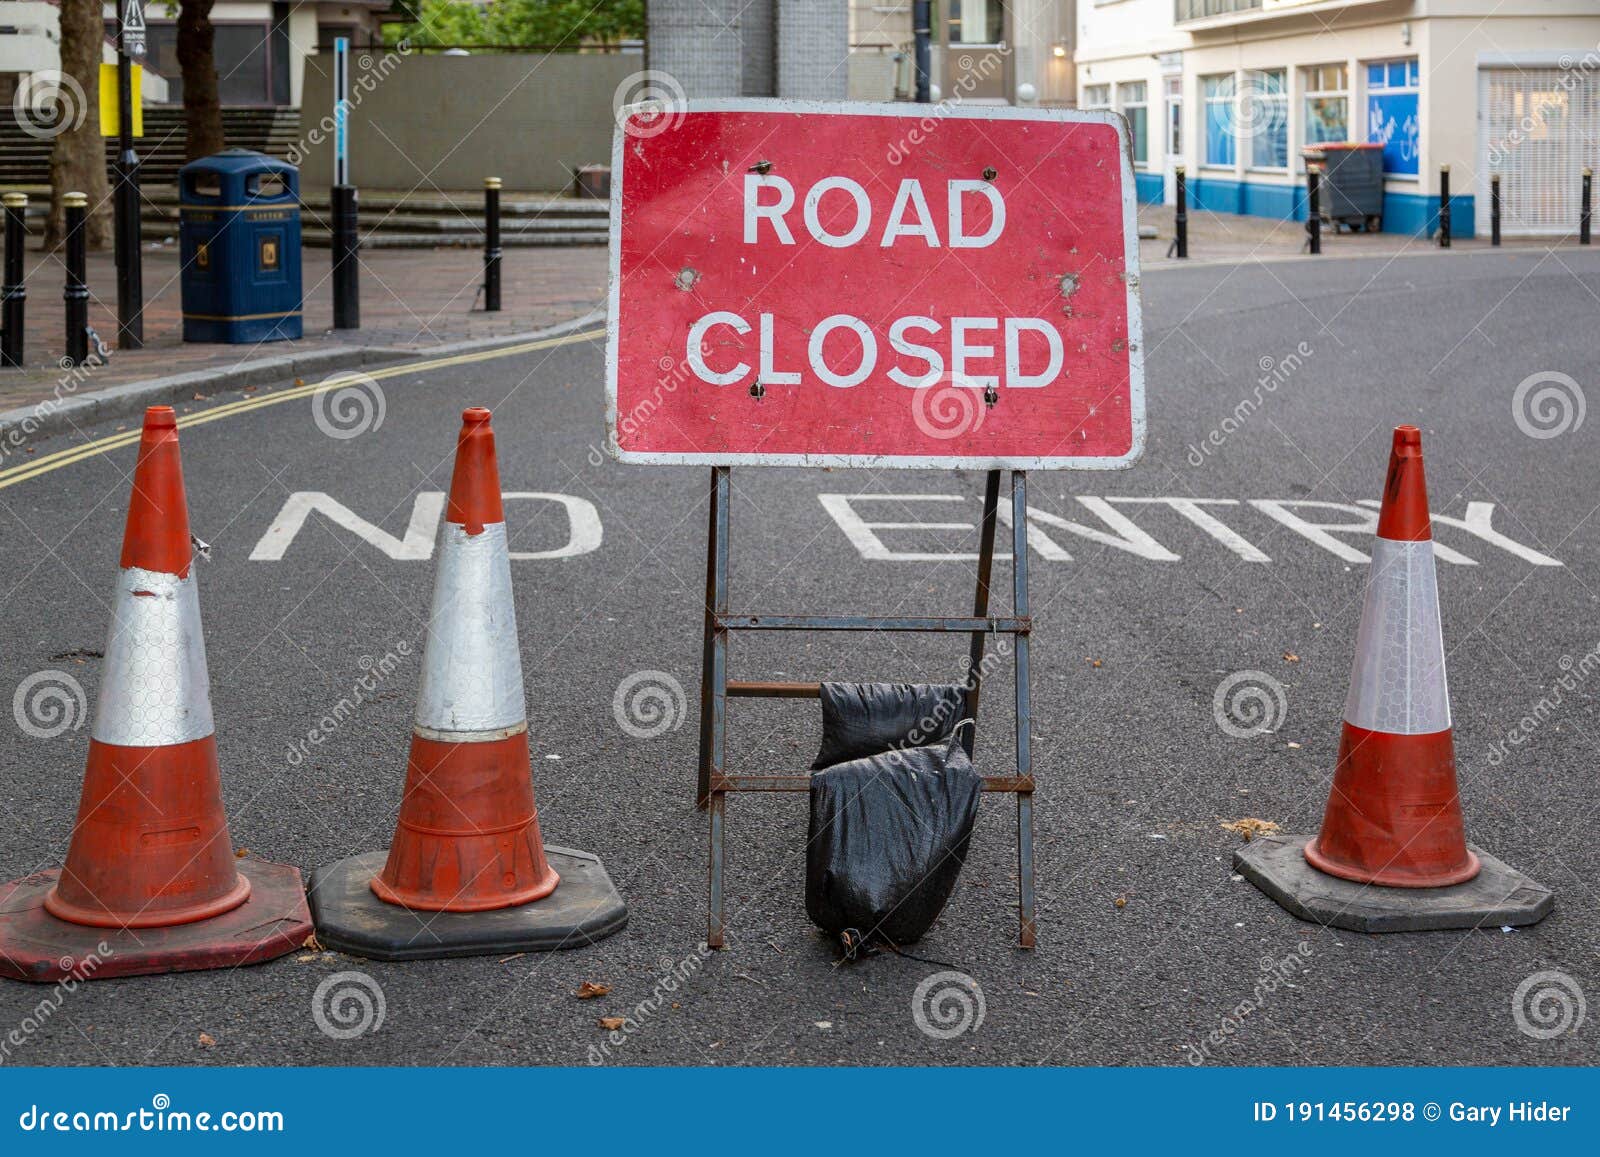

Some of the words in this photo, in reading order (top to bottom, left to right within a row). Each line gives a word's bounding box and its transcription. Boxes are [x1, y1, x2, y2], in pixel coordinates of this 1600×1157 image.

[743, 173, 1007, 249] ROAD
[686, 311, 1064, 389] CLOSED
[249, 491, 604, 561] NO
[817, 493, 1564, 567] ENTRY
